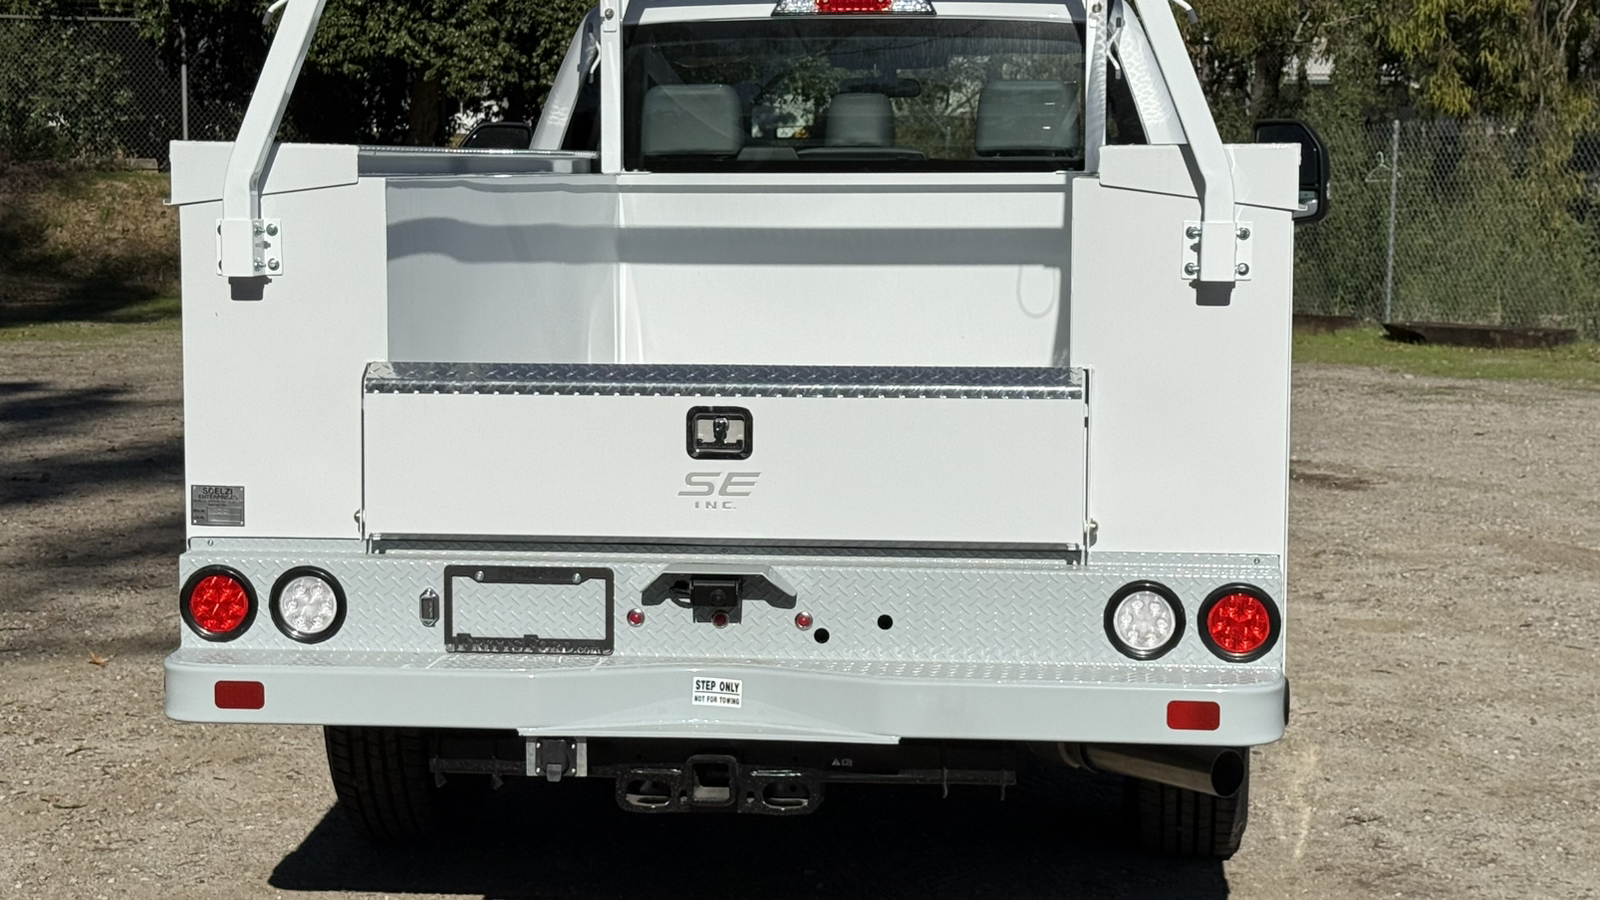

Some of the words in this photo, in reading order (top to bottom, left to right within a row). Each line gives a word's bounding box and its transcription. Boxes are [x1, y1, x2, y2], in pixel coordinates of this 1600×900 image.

[678, 472, 761, 496] SE
[695, 501, 736, 509] INC.
[695, 680, 715, 690] STEP
[719, 681, 739, 692] ONLY
[720, 697, 739, 705] TOWING
